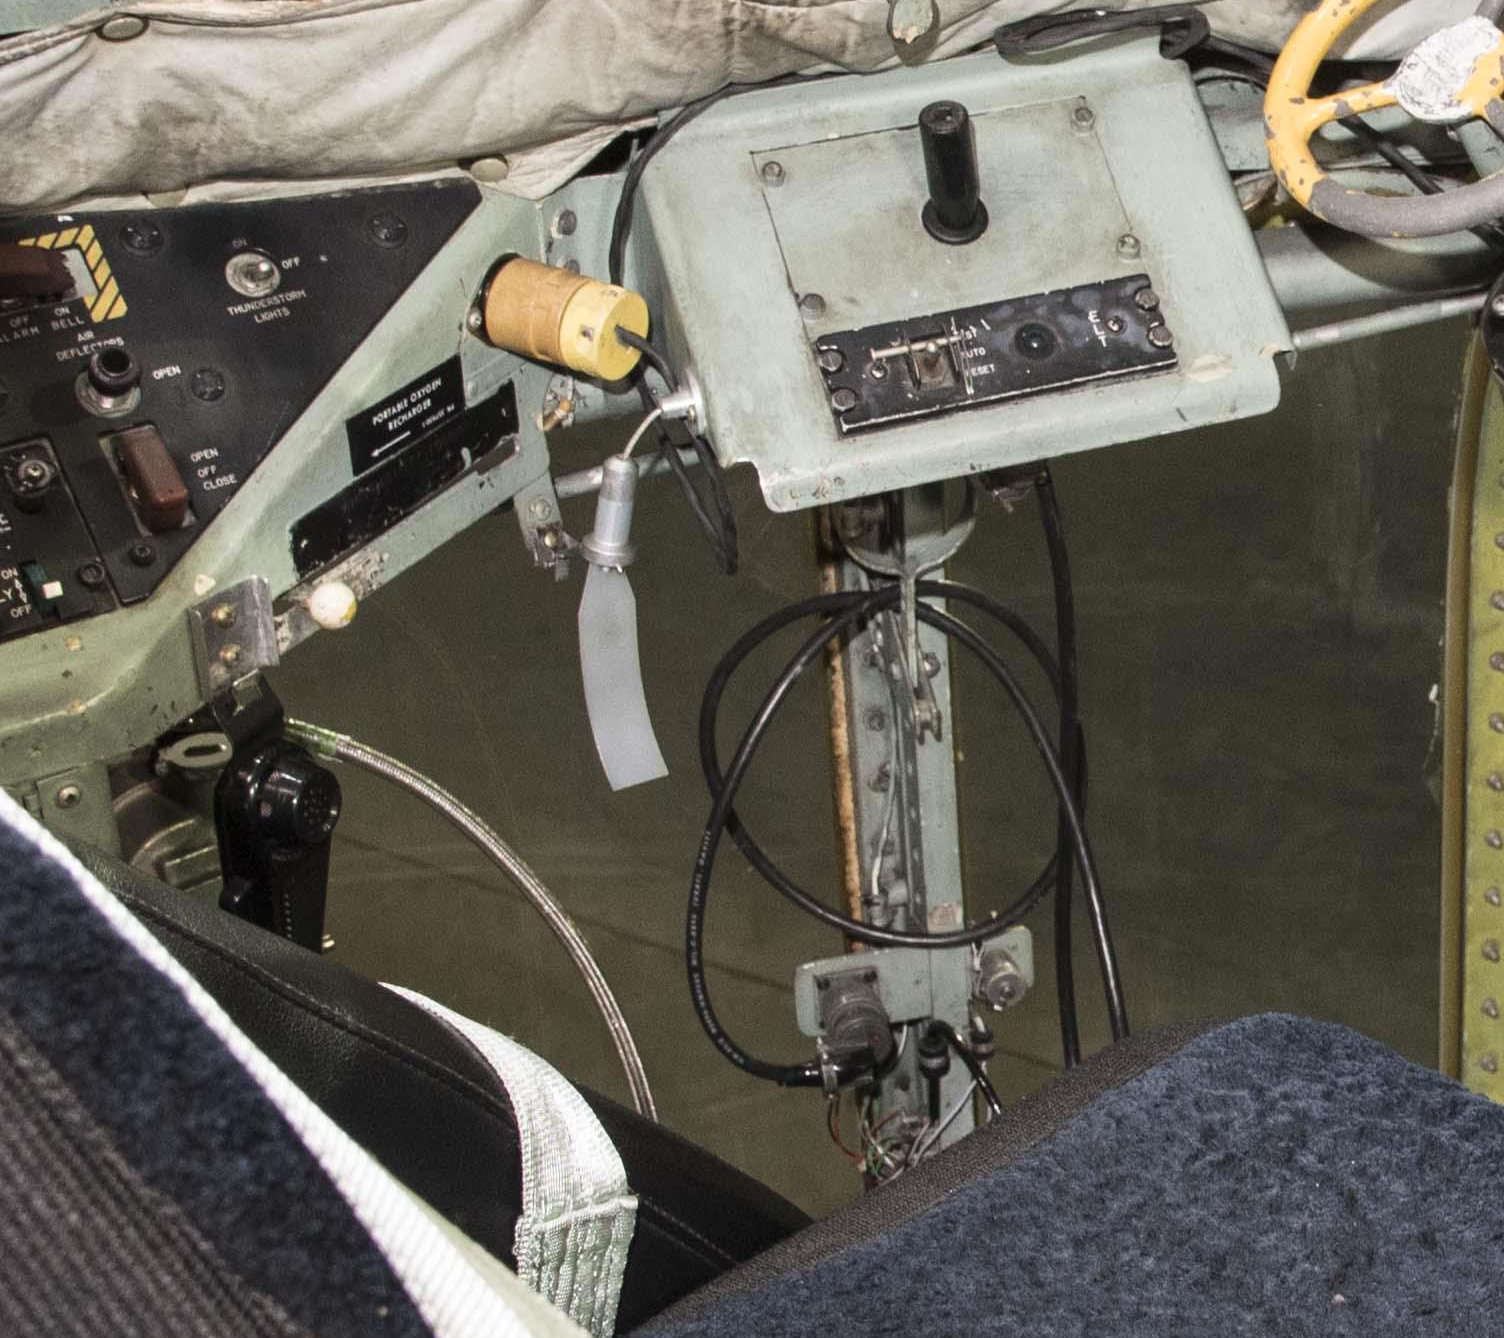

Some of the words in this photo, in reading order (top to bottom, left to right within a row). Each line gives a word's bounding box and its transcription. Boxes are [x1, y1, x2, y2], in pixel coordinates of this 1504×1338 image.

[226, 290, 306, 317] THUNDERSTORM
[254, 308, 290, 324] LIGHTS
[153, 365, 181, 380] OPEN
[373, 400, 408, 425] PORTABLE
[410, 378, 442, 402] OXYGEN
[191, 448, 219, 462] OPEN
[203, 474, 237, 490] CLOSE
